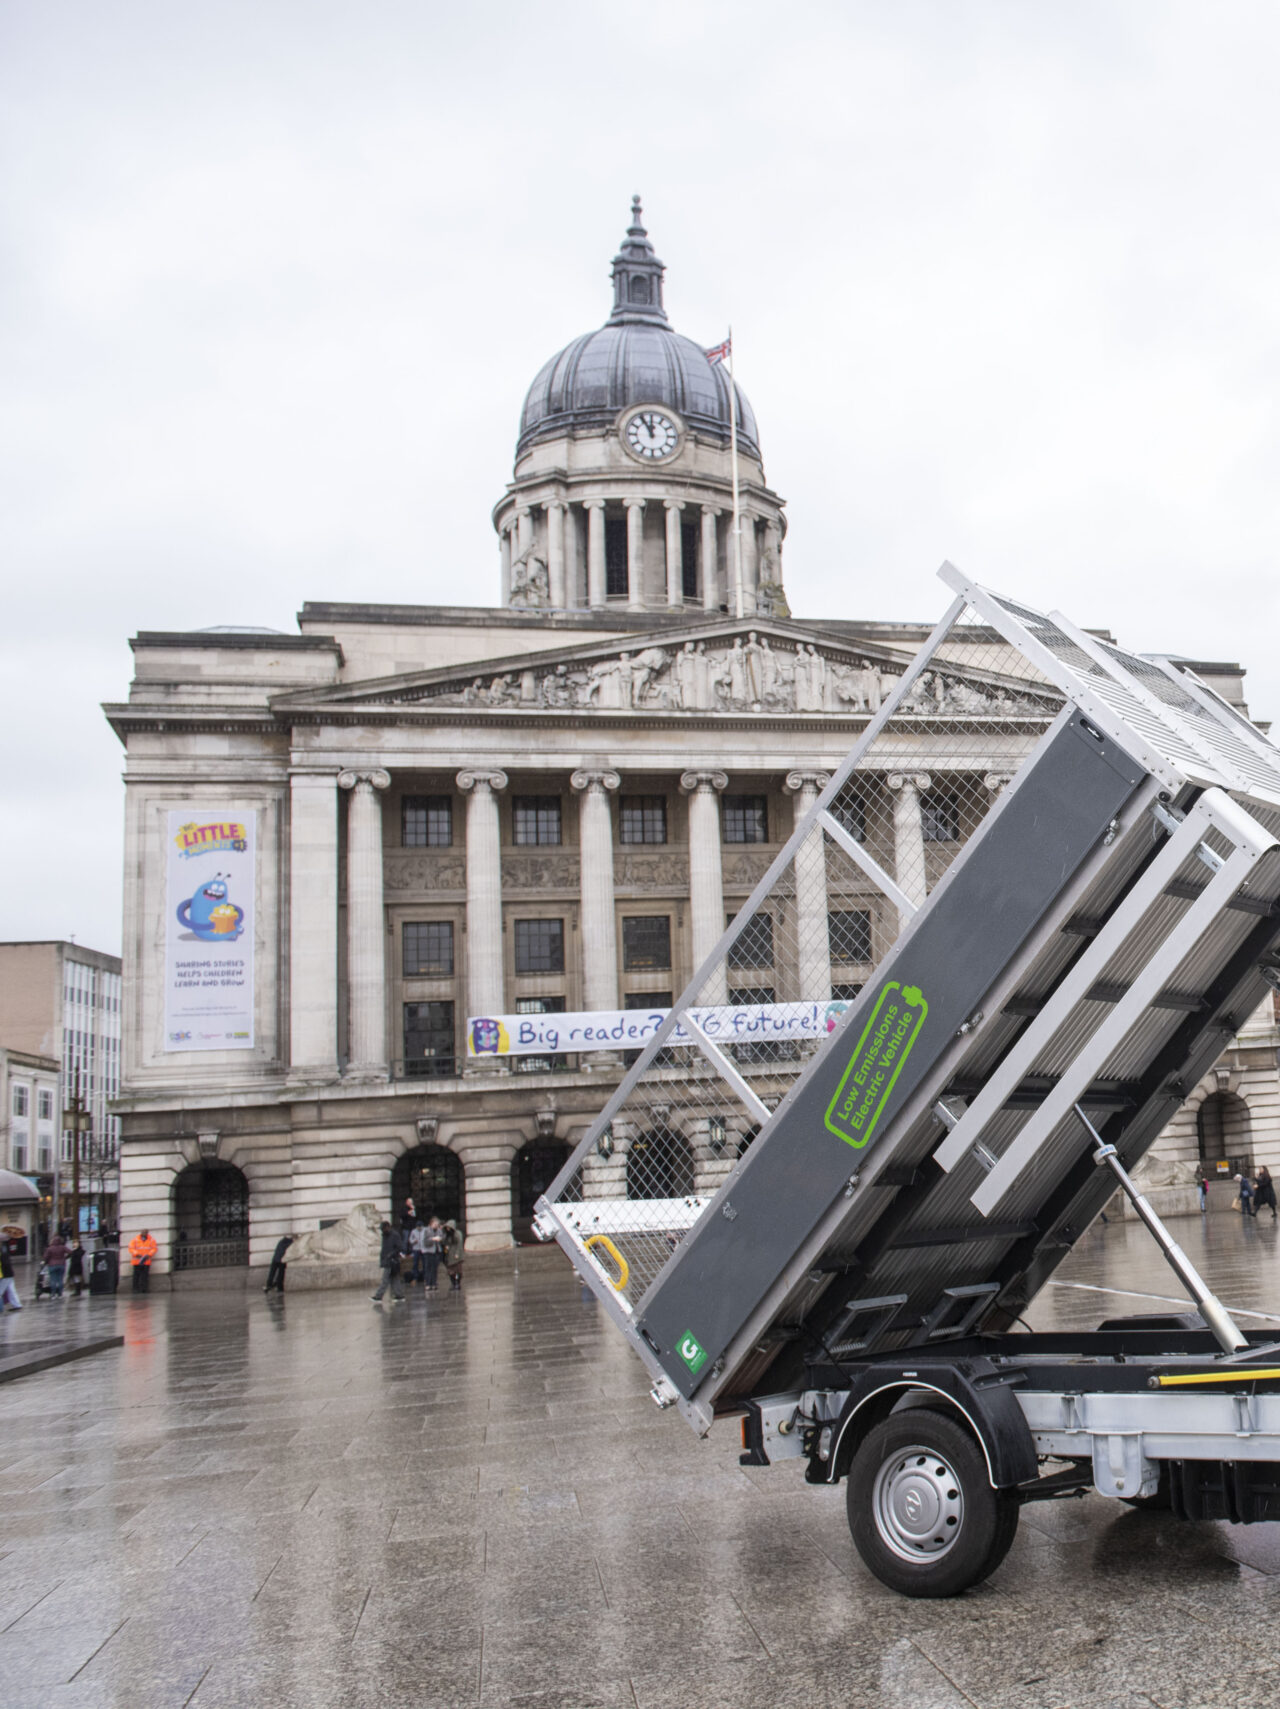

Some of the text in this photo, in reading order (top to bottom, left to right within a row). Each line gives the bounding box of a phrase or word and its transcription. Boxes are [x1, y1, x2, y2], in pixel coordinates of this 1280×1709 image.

[183, 824, 241, 848] LITTLE
[175, 960, 245, 969] SHARING STORIES
[177, 969, 243, 978] HELPS CHILDREN
[174, 980, 200, 988] LEARN
[518, 1021, 559, 1050] Big
[569, 1014, 665, 1040] reader?
[731, 1005, 818, 1033] future!
[837, 1003, 898, 1121] Low Emissions
[850, 1011, 913, 1130] Electric Vehicle
